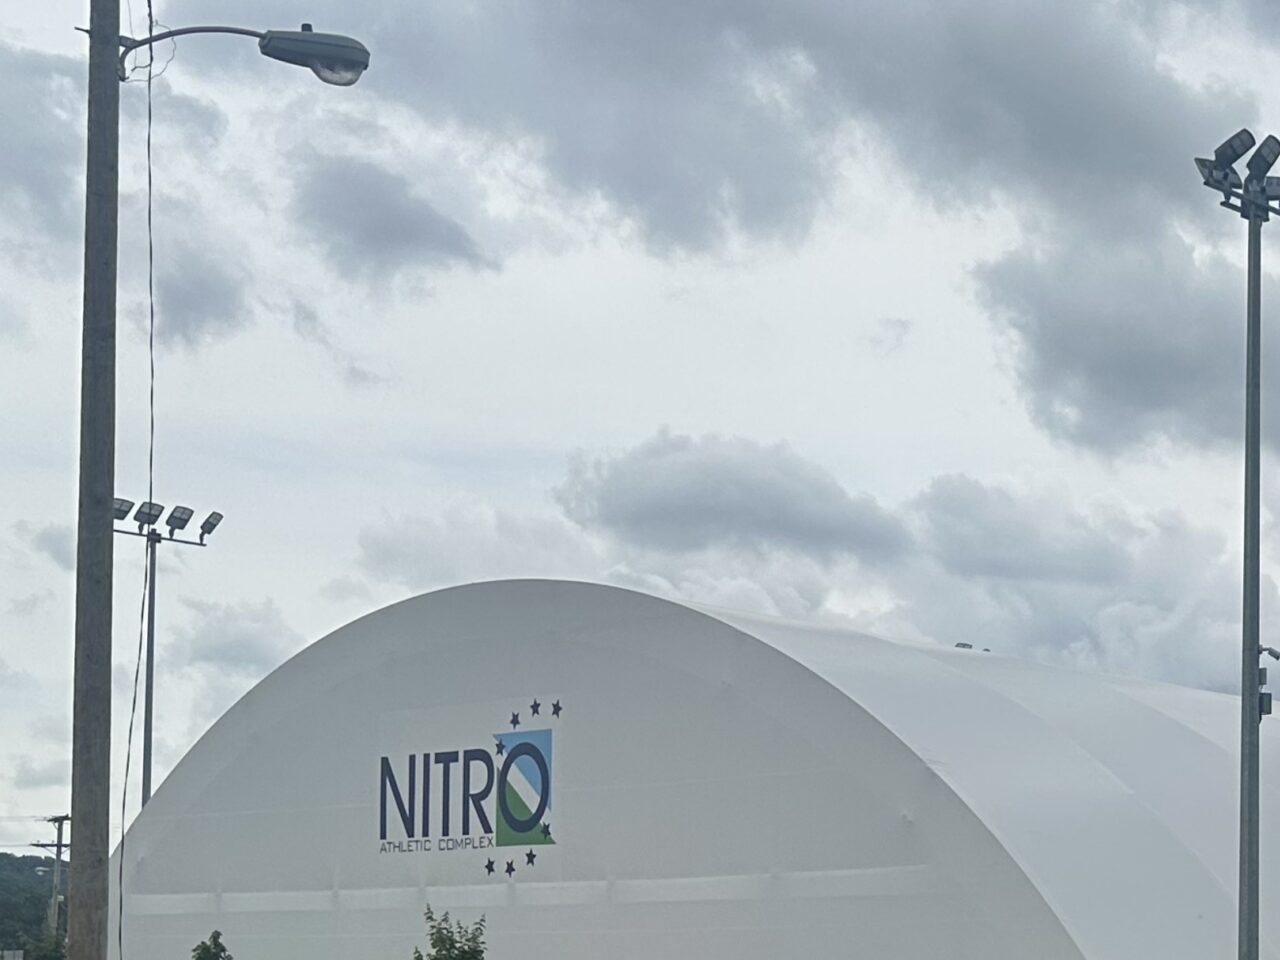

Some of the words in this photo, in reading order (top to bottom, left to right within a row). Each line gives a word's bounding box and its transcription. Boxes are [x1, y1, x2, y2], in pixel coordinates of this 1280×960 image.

[380, 742, 549, 840] NITRO
[379, 839, 431, 853] ATHLETIC
[438, 836, 494, 851] COMPLEX
